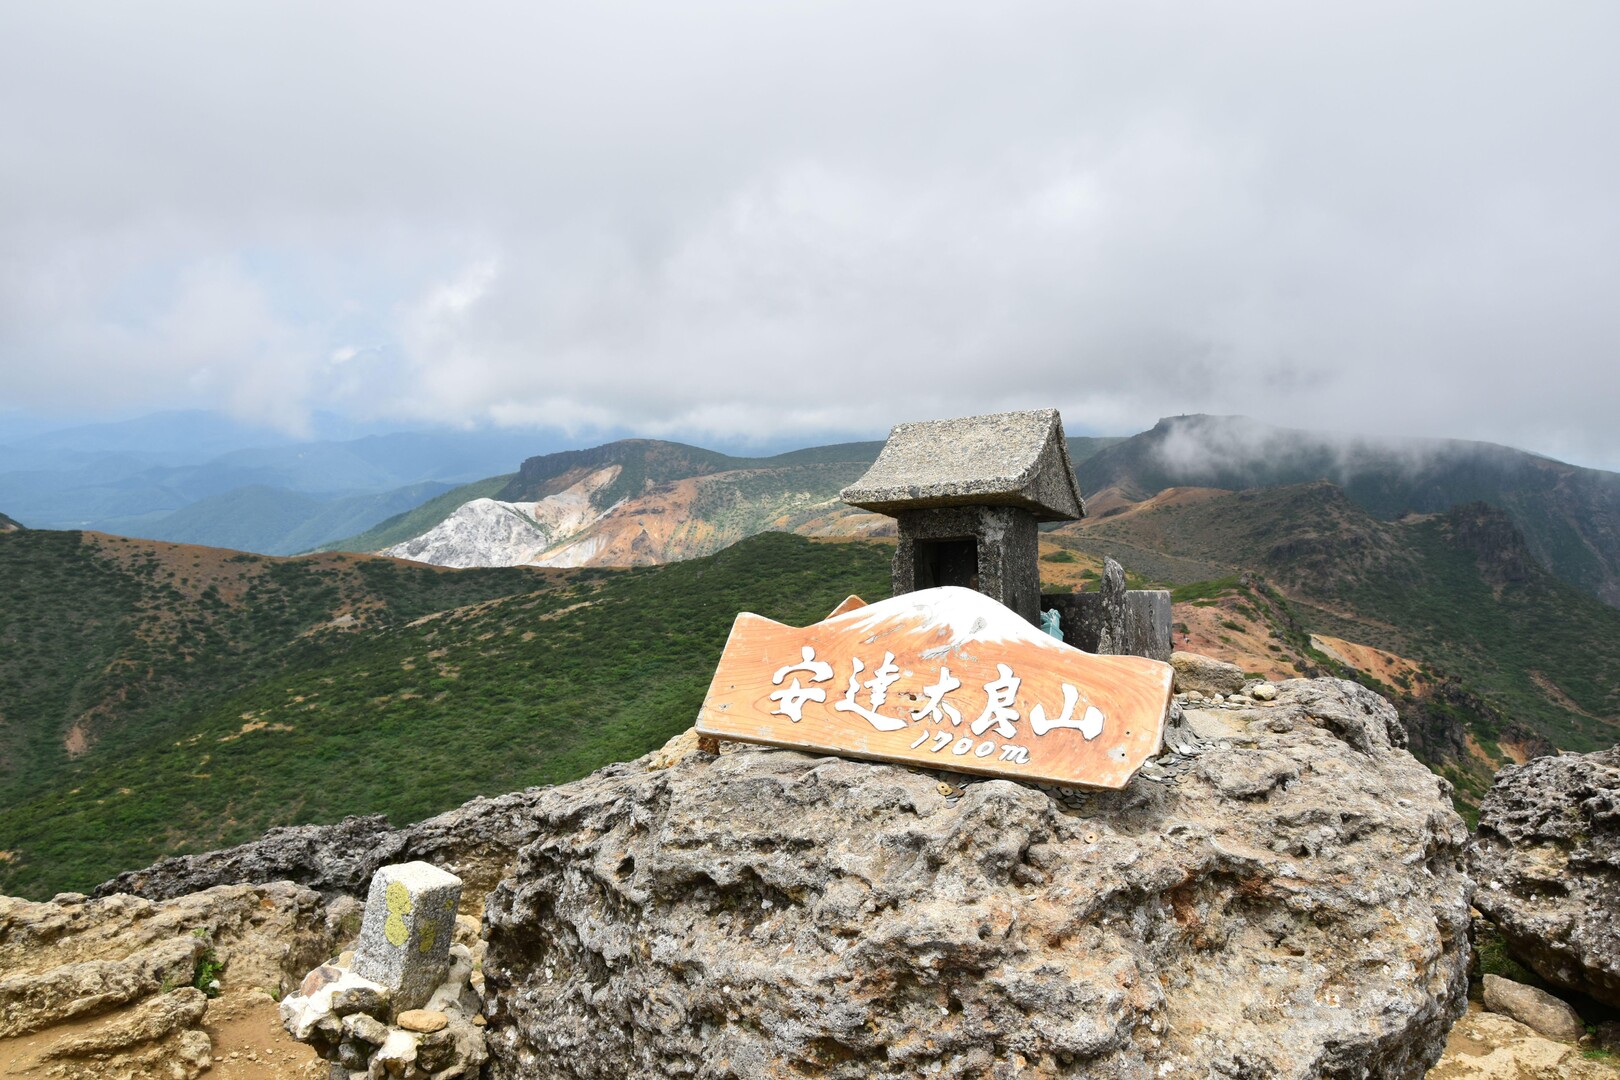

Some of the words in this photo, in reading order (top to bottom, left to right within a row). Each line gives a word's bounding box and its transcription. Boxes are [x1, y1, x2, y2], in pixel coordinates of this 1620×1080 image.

[770, 646, 1104, 740] 安達太良山
[910, 729, 1030, 764] 1700m
